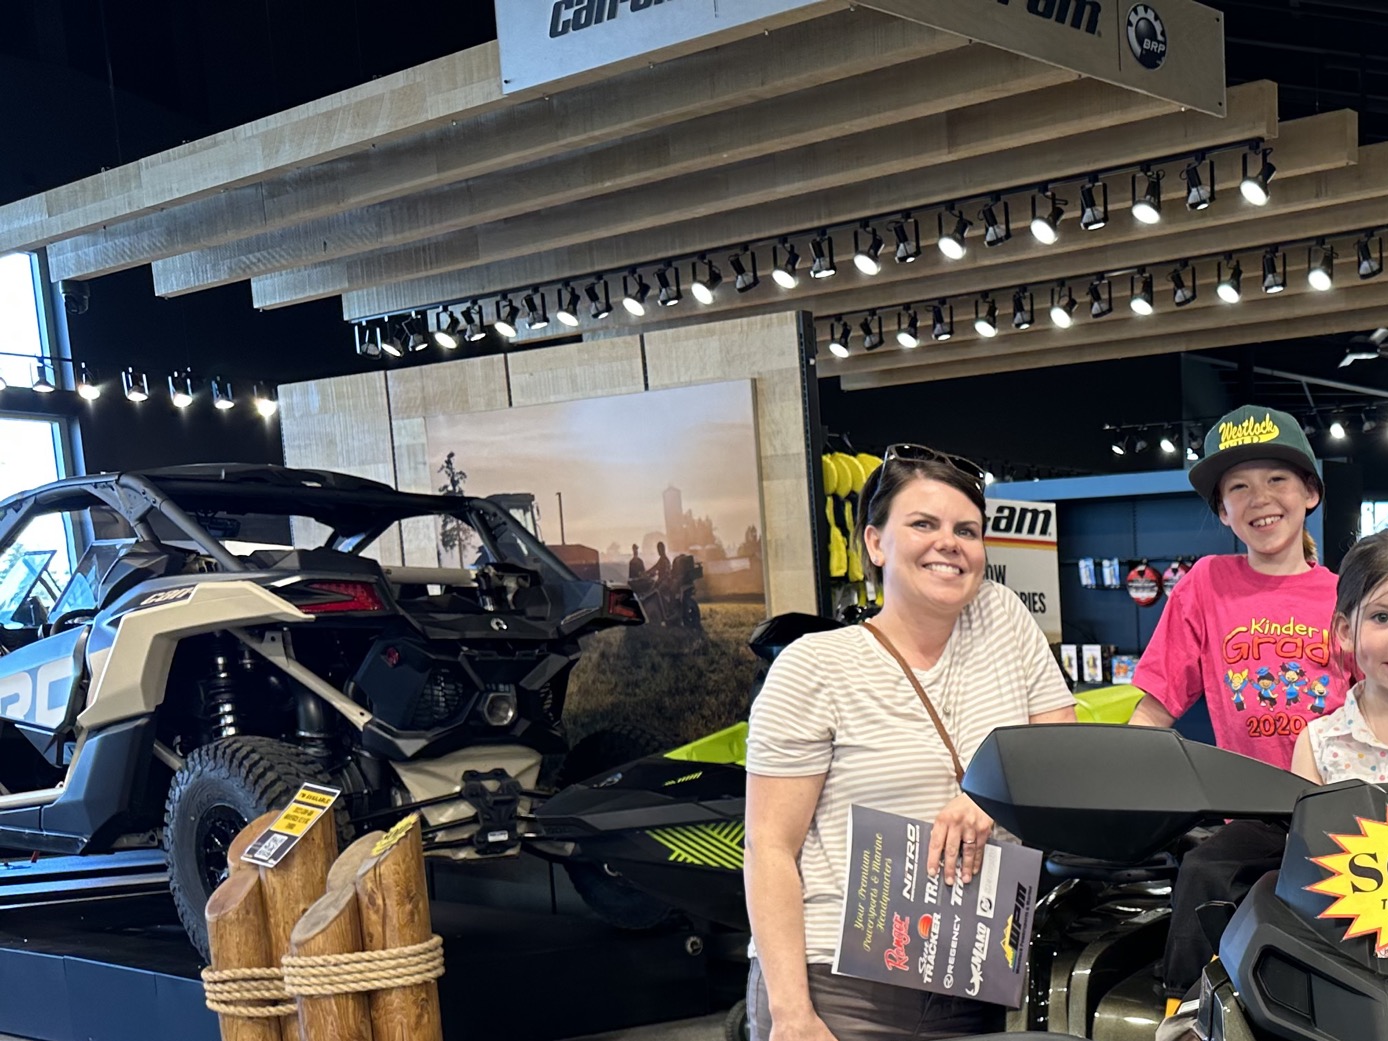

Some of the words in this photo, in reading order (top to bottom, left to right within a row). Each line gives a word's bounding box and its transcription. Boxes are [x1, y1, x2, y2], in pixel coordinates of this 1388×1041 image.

[1142, 38, 1166, 53] BRP
[1219, 413, 1276, 442] Westlock
[1014, 591, 1046, 613] RIES
[1222, 626, 1330, 667] Grad
[1250, 617, 1318, 637] Kinder
[1246, 712, 1307, 737] 2020
[858, 848, 870, 901] Premium
[863, 887, 878, 953] Powersports
[872, 832, 883, 873] Marine
[876, 857, 892, 933] Headquarters
[854, 902, 865, 931] Your
[1008, 881, 1027, 948] WPM
[884, 911, 911, 972] Ranger
[923, 912, 942, 984] TRACKER
[948, 914, 961, 975] REGENCY
